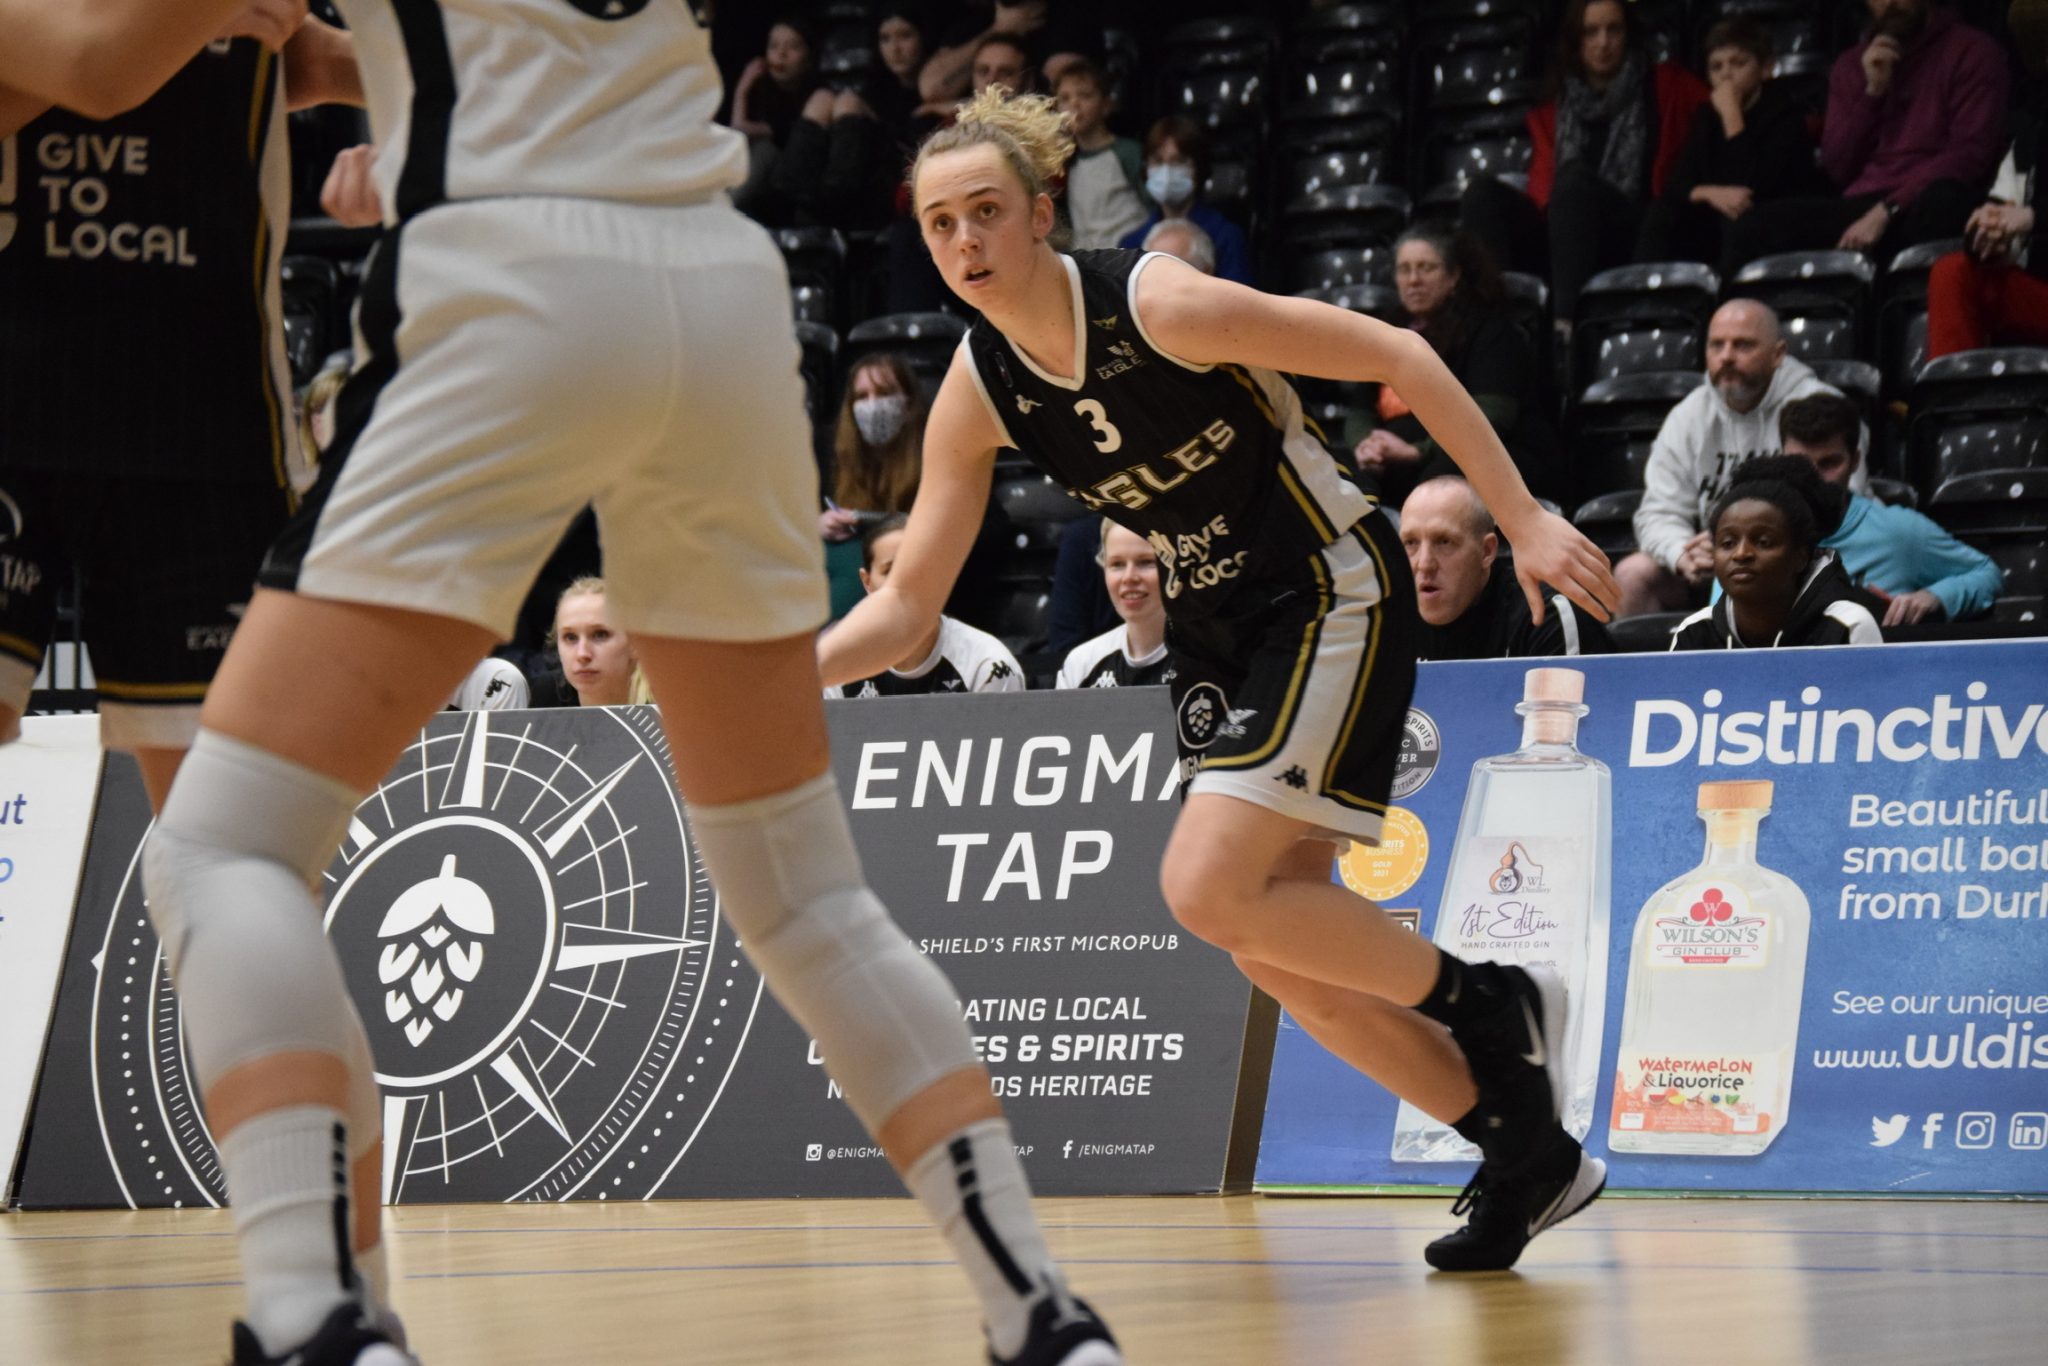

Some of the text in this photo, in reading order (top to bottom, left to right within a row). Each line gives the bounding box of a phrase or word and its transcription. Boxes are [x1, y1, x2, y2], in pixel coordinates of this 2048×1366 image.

[38, 133, 148, 175] GIVE
[39, 176, 108, 216] TO
[45, 220, 197, 267] LOCAL
[1098, 353, 1148, 380] EAGLE
[1073, 398, 1122, 453] 3
[1849, 787, 2048, 828] Beautiful
[936, 830, 1114, 903] TAP
[1841, 837, 1967, 874] small
[1837, 884, 1942, 921] from
[1459, 901, 1560, 939] 1st Edition
[1662, 926, 1759, 944] WILSON'S
[918, 937, 1005, 955] SHIELD'S
[1012, 936, 1066, 953] FIRST
[1071, 934, 1179, 952] MICROPUB
[1461, 940, 1551, 949] HAND CRAFTED GIN
[1672, 946, 1743, 956] GIN CLUB
[959, 996, 1148, 1022] ATING LOCAL
[1832, 987, 2048, 1020] See our unique
[1017, 1034, 1042, 1063] &
[1050, 1033, 1185, 1062] SPIRITS
[1029, 1075, 1153, 1097] HERITAGE
[1658, 1073, 1745, 1091] Liquorice
[827, 1146, 888, 1160] @ENIGMA
[1078, 1143, 1156, 1158] /ENIGMATAP
